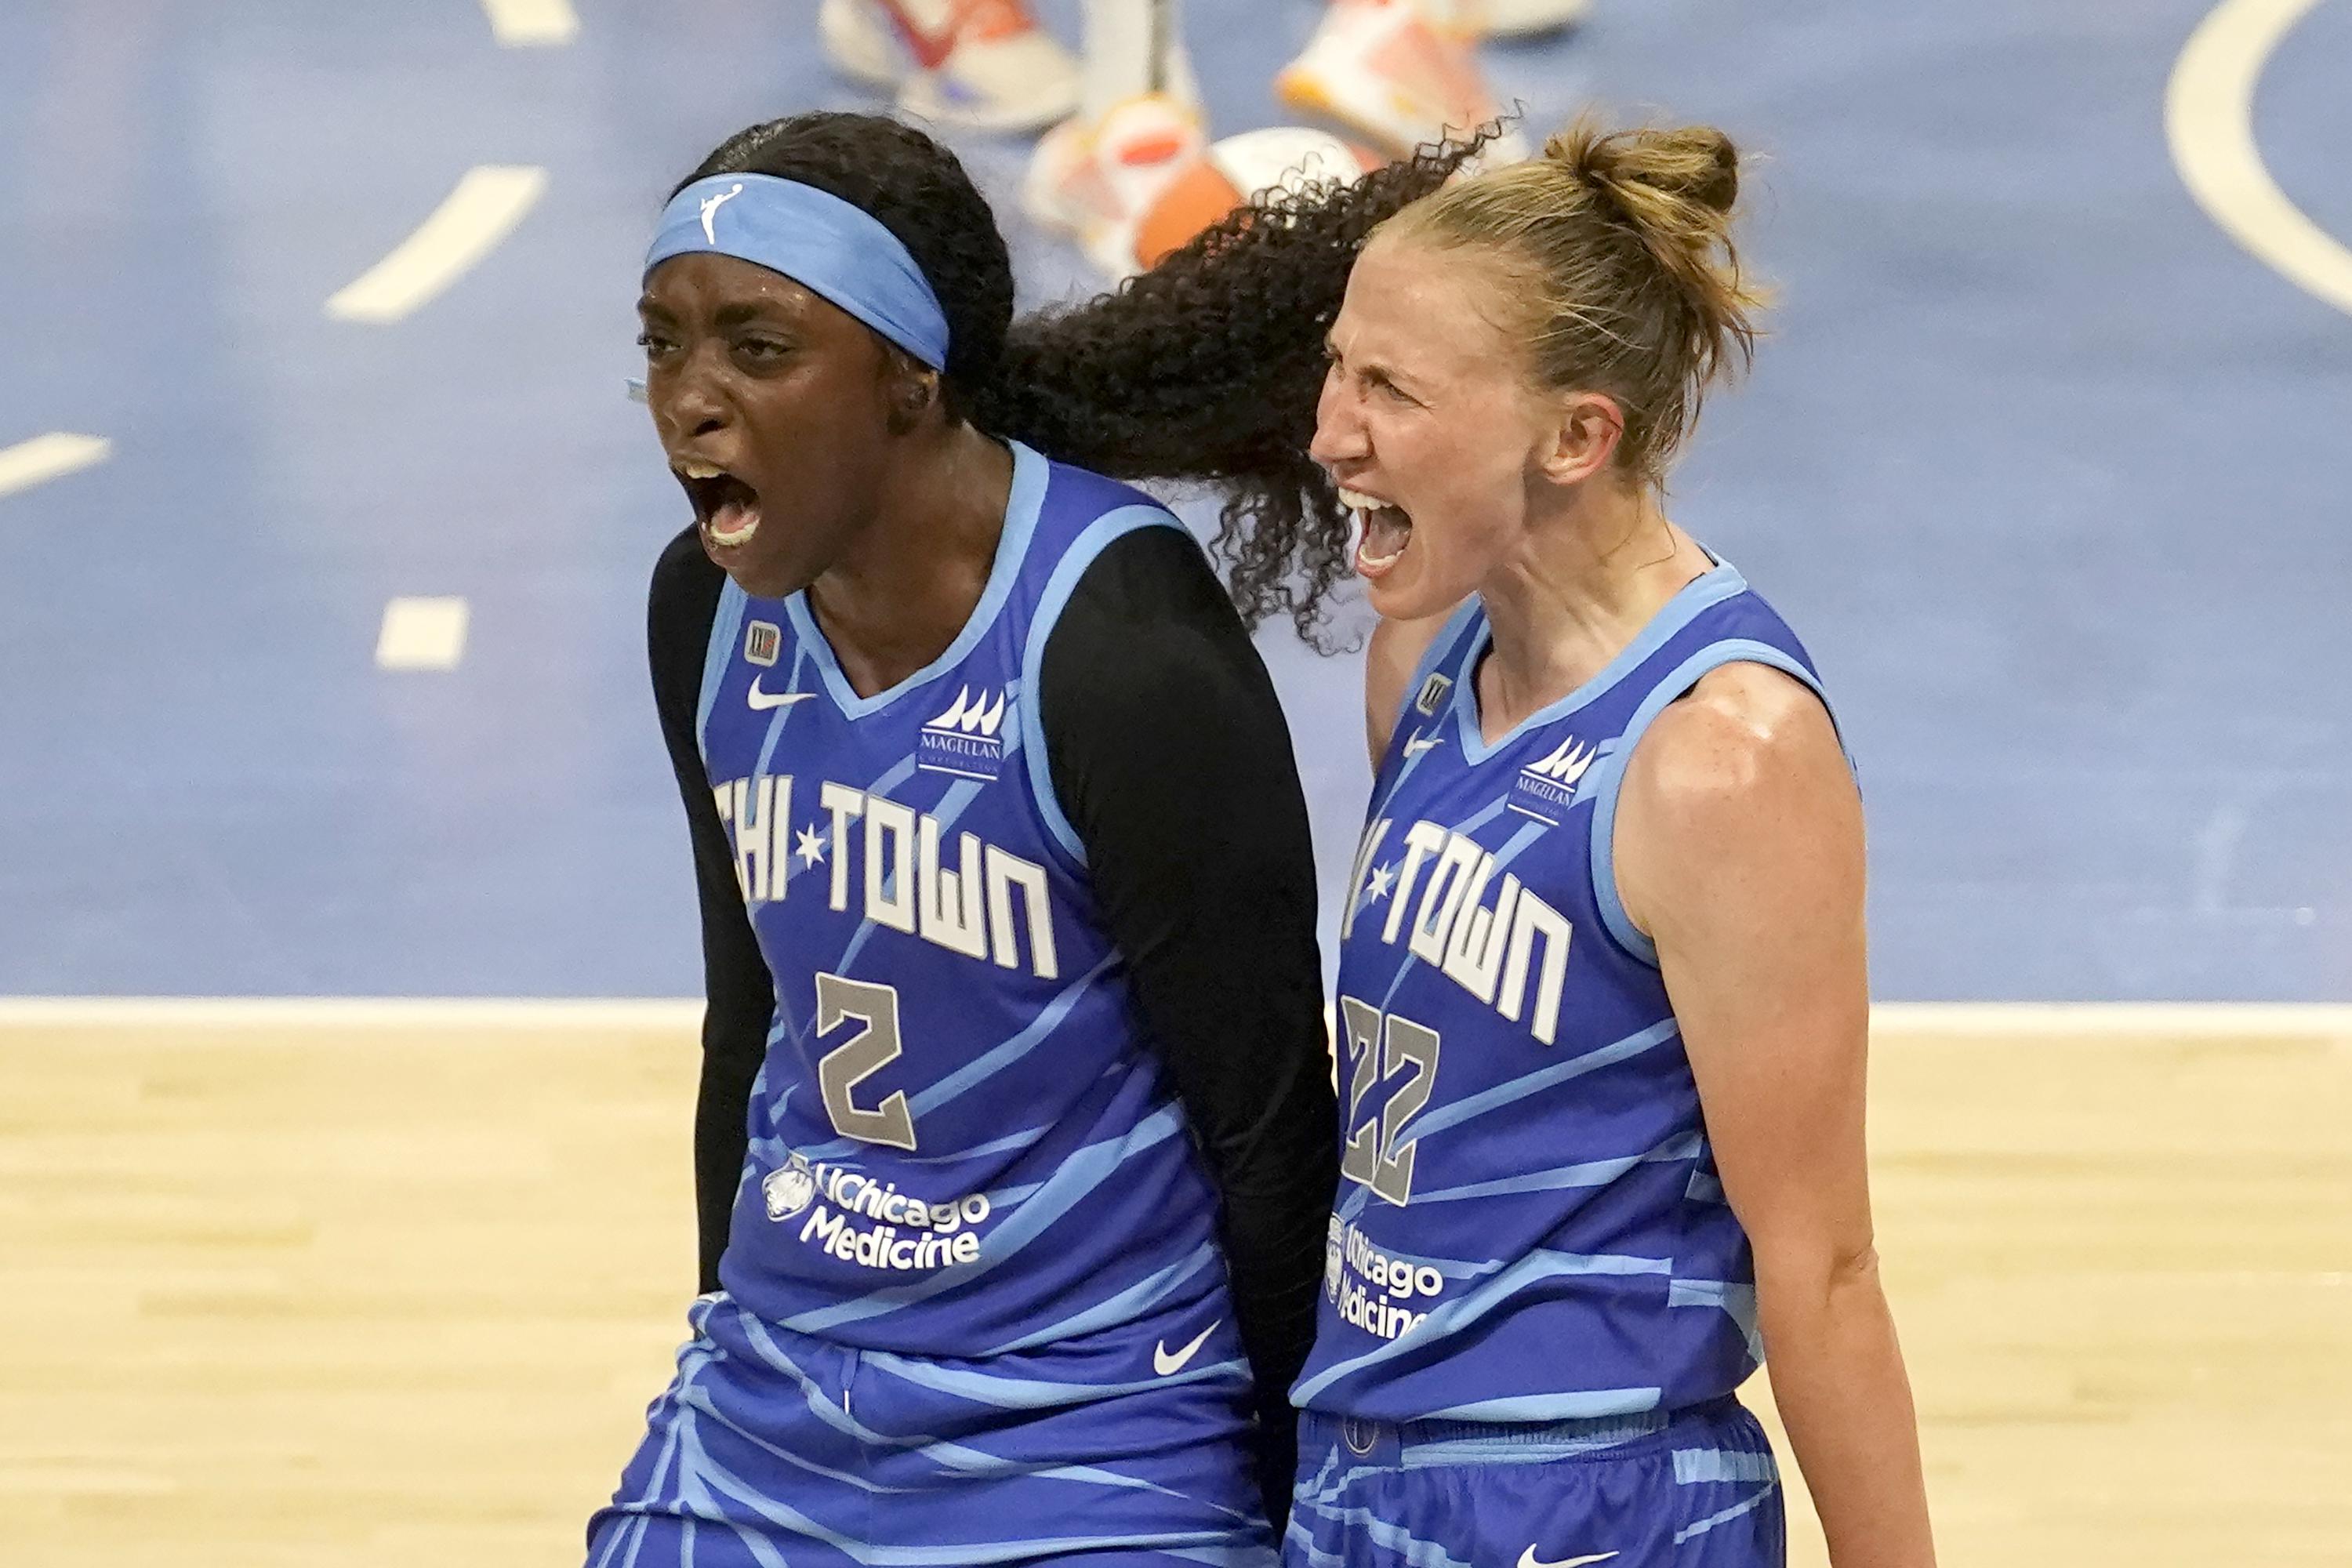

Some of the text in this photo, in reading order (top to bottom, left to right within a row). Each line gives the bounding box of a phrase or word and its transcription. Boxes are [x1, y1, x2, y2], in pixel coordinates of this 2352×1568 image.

[920, 733, 1000, 760] MAGELLAN
[1515, 776, 1572, 806] MAGELLAN
[820, 780, 1058, 979] TOWN
[1381, 819, 1573, 1046] TOWN
[815, 971, 917, 1152] 2
[1340, 994, 1440, 1208] 22
[799, 1205, 980, 1271] Medicine
[815, 1163, 991, 1233] UChicago
